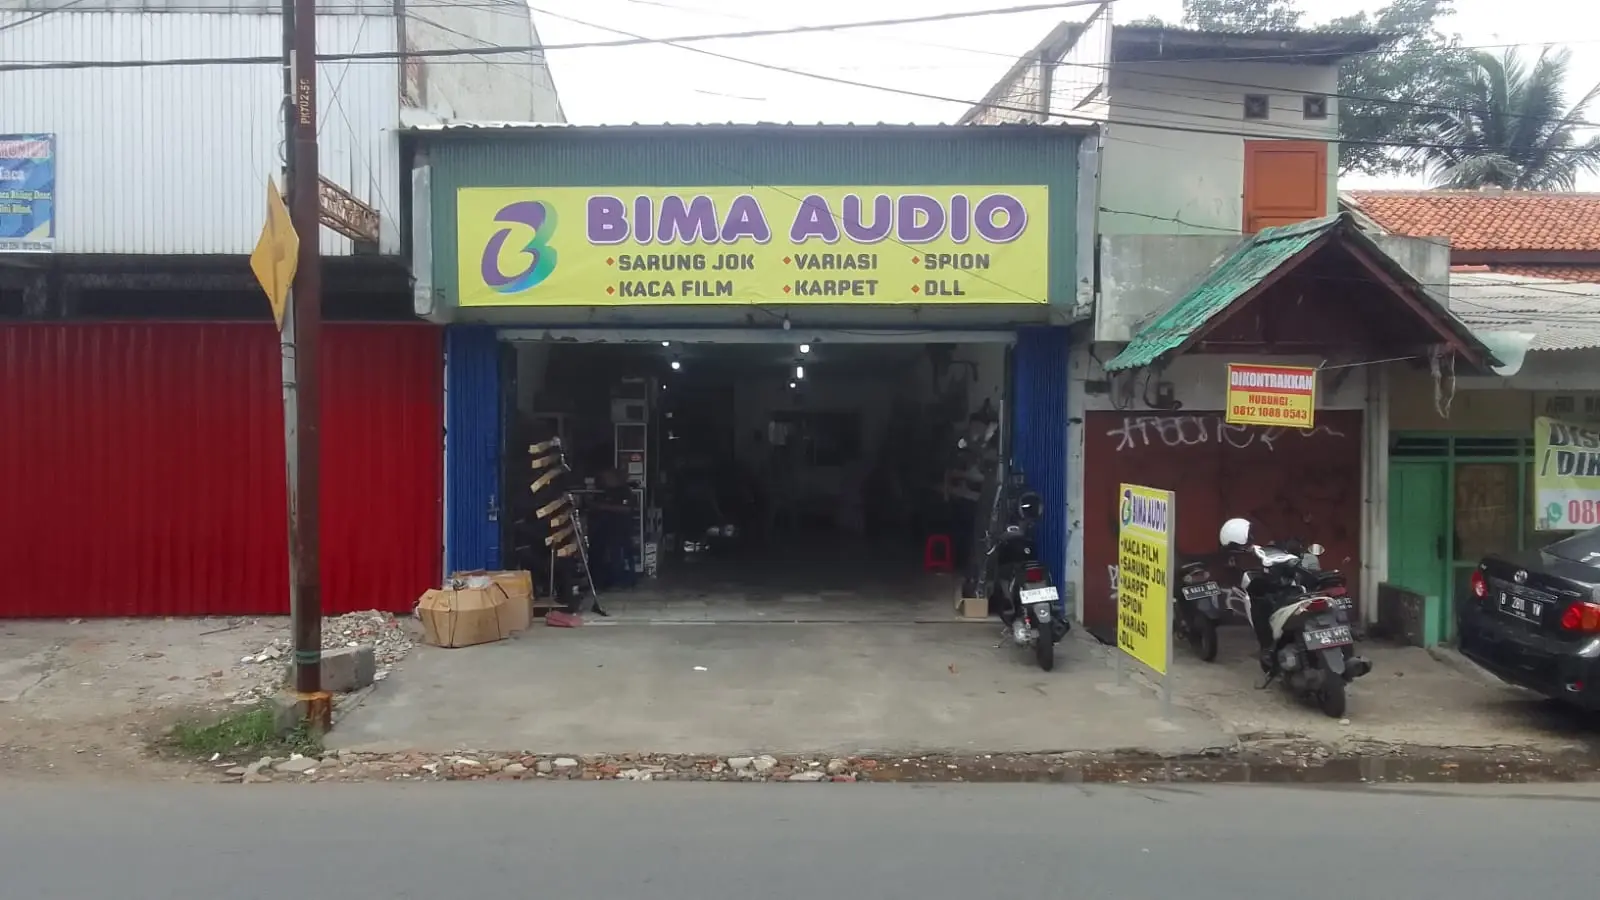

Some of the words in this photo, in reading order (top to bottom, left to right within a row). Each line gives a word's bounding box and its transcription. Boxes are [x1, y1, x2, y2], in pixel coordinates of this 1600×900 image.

[586, 194, 772, 244] BIMA
[789, 193, 1029, 244] AUDIO
[619, 254, 706, 271] SARUNG
[712, 254, 755, 270] JOK
[794, 253, 878, 270] VARIASI
[924, 253, 990, 270] SPION
[619, 280, 676, 297] KACA
[681, 280, 734, 297] FILM
[794, 279, 879, 296] KARPET
[924, 279, 966, 296] DLL
[1231, 371, 1313, 390] DIKONTRAKKAN
[1233, 405, 1256, 416] 0812
[1283, 408, 1307, 420] 0543
[1133, 495, 1147, 527] BIMA
[1147, 497, 1167, 533] AUDIO
[1123, 538, 1140, 557] KACA
[1142, 543, 1159, 563] FILM
[1123, 556, 1150, 579] SARUNG
[1151, 568, 1166, 587] JOK
[1123, 575, 1149, 599] KARPET
[1122, 594, 1142, 617] SPION
[1501, 592, 1506, 605] B
[1122, 612, 1148, 639] VARIASI
[1122, 630, 1135, 651] DLL
